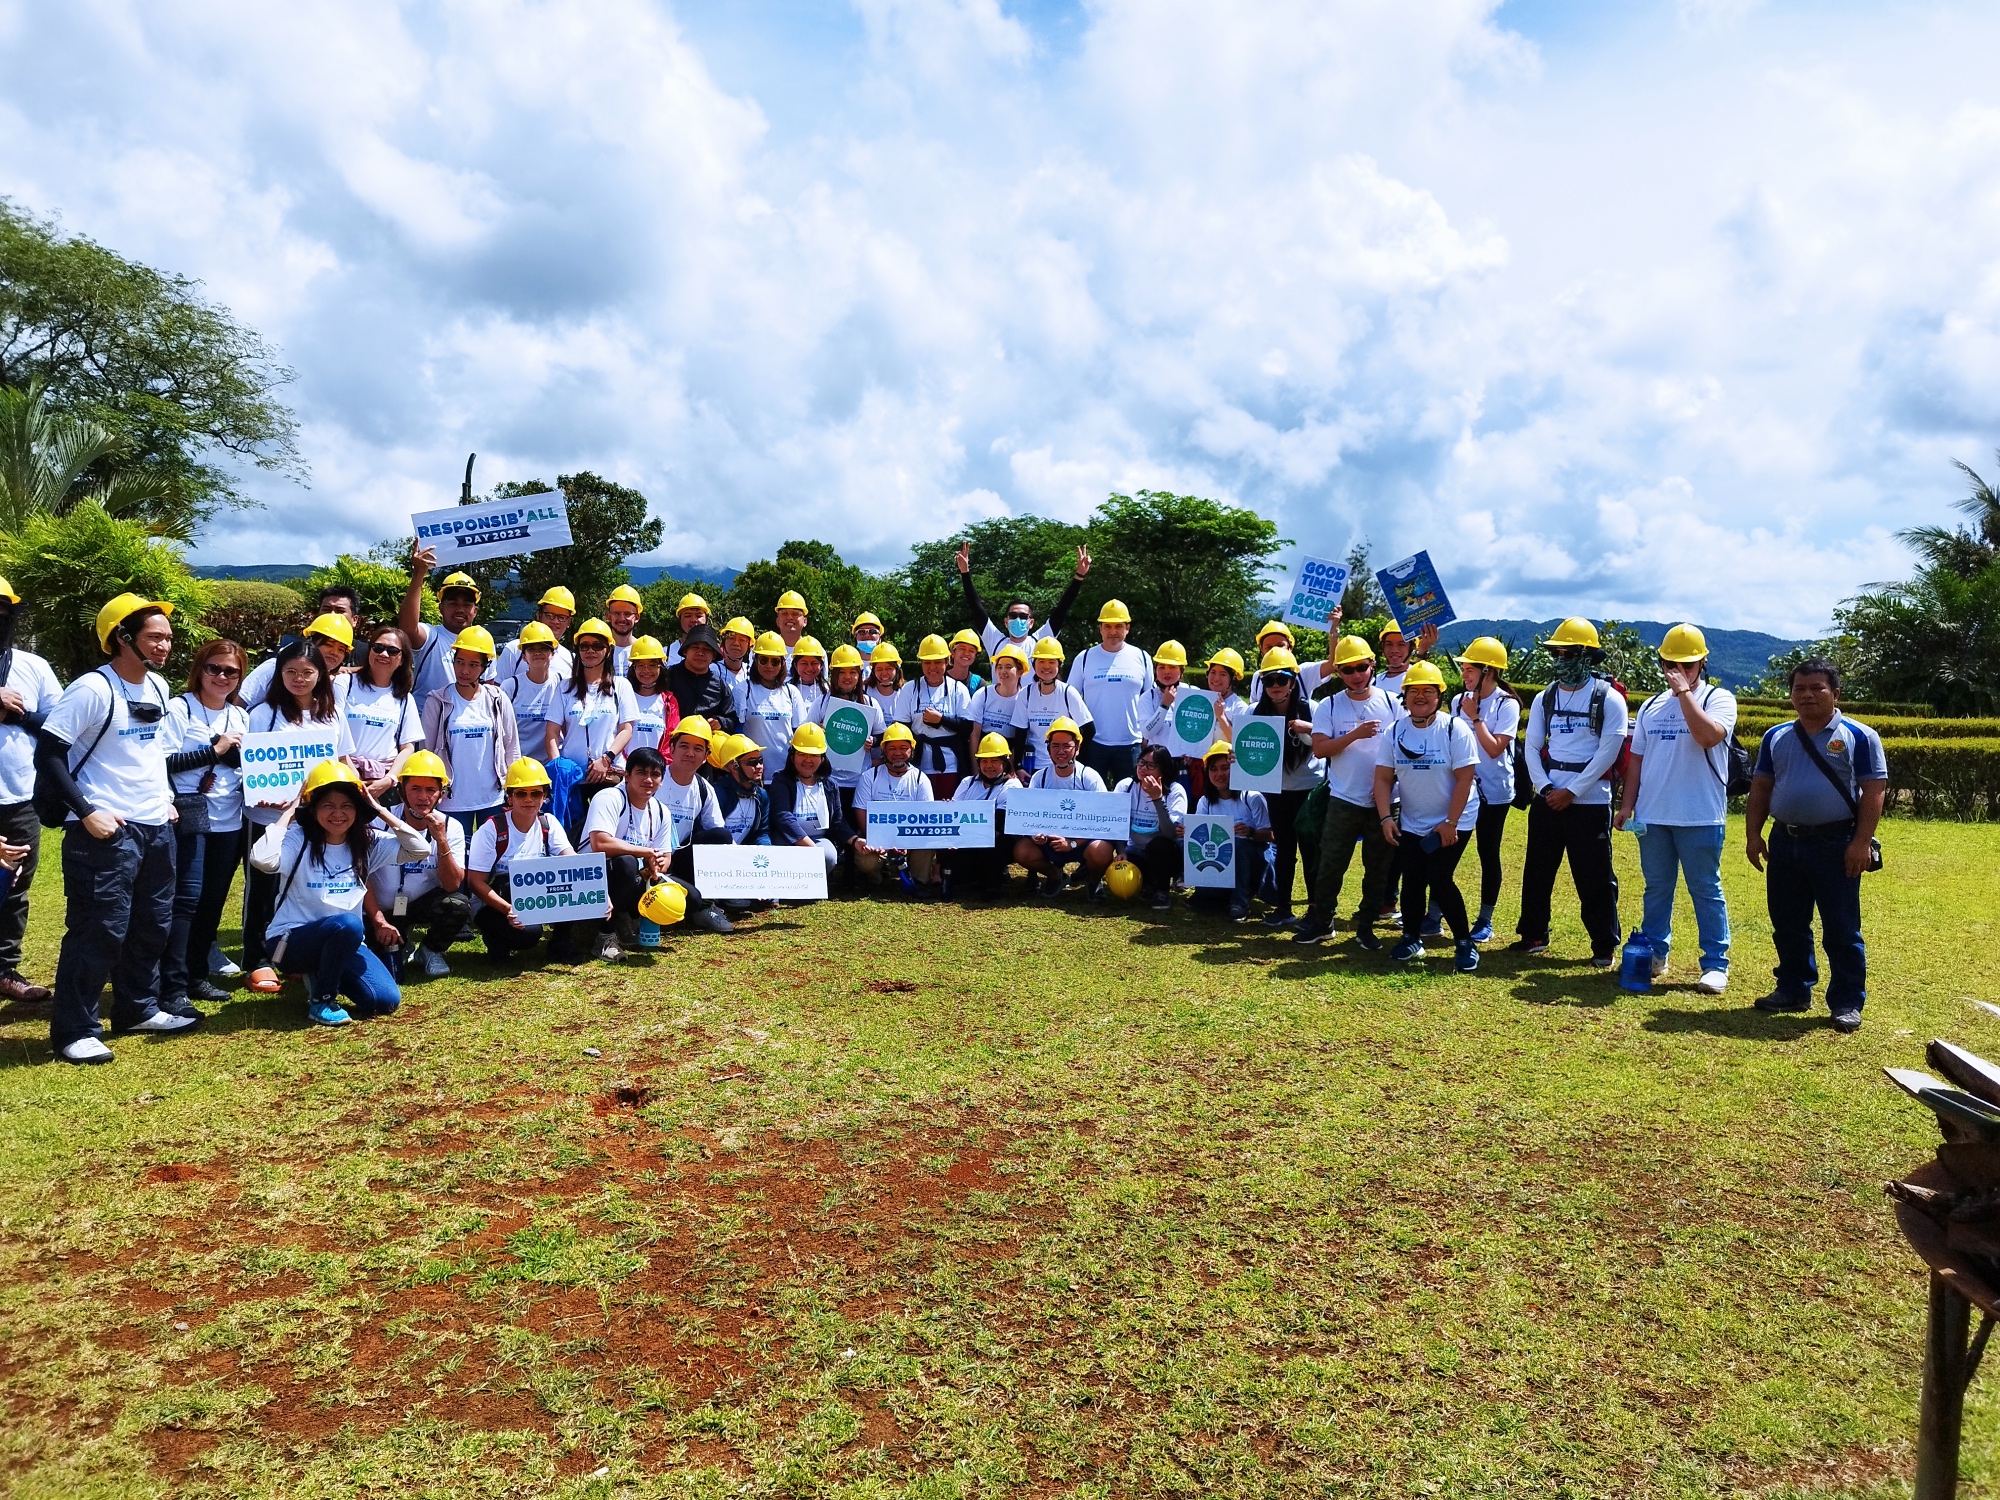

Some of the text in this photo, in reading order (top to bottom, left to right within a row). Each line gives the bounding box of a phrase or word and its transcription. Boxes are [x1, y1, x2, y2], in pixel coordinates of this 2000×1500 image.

[418, 507, 558, 538] RESPONSIB'ALL
[465, 528, 521, 544] DAY 2022
[1305, 561, 1346, 580] GOOD
[1302, 573, 1342, 593] TIMES
[1294, 592, 1335, 612] GOOD
[1181, 710, 1209, 720] TERROIR
[832, 721, 863, 734] TERROIR
[244, 743, 334, 762] GOOD TIMES
[1241, 740, 1275, 749] TERROIR
[246, 772, 289, 789] GOOD
[869, 811, 988, 823] RESPONSIB'ALL
[1007, 808, 1040, 818] Pernod
[1043, 811, 1073, 820] Ricard
[1075, 812, 1128, 823] Philippines
[513, 866, 603, 887] GOOD TIMES
[697, 869, 824, 880] Pernod Ricard Philippines
[514, 890, 605, 911] GOOD PLACE
